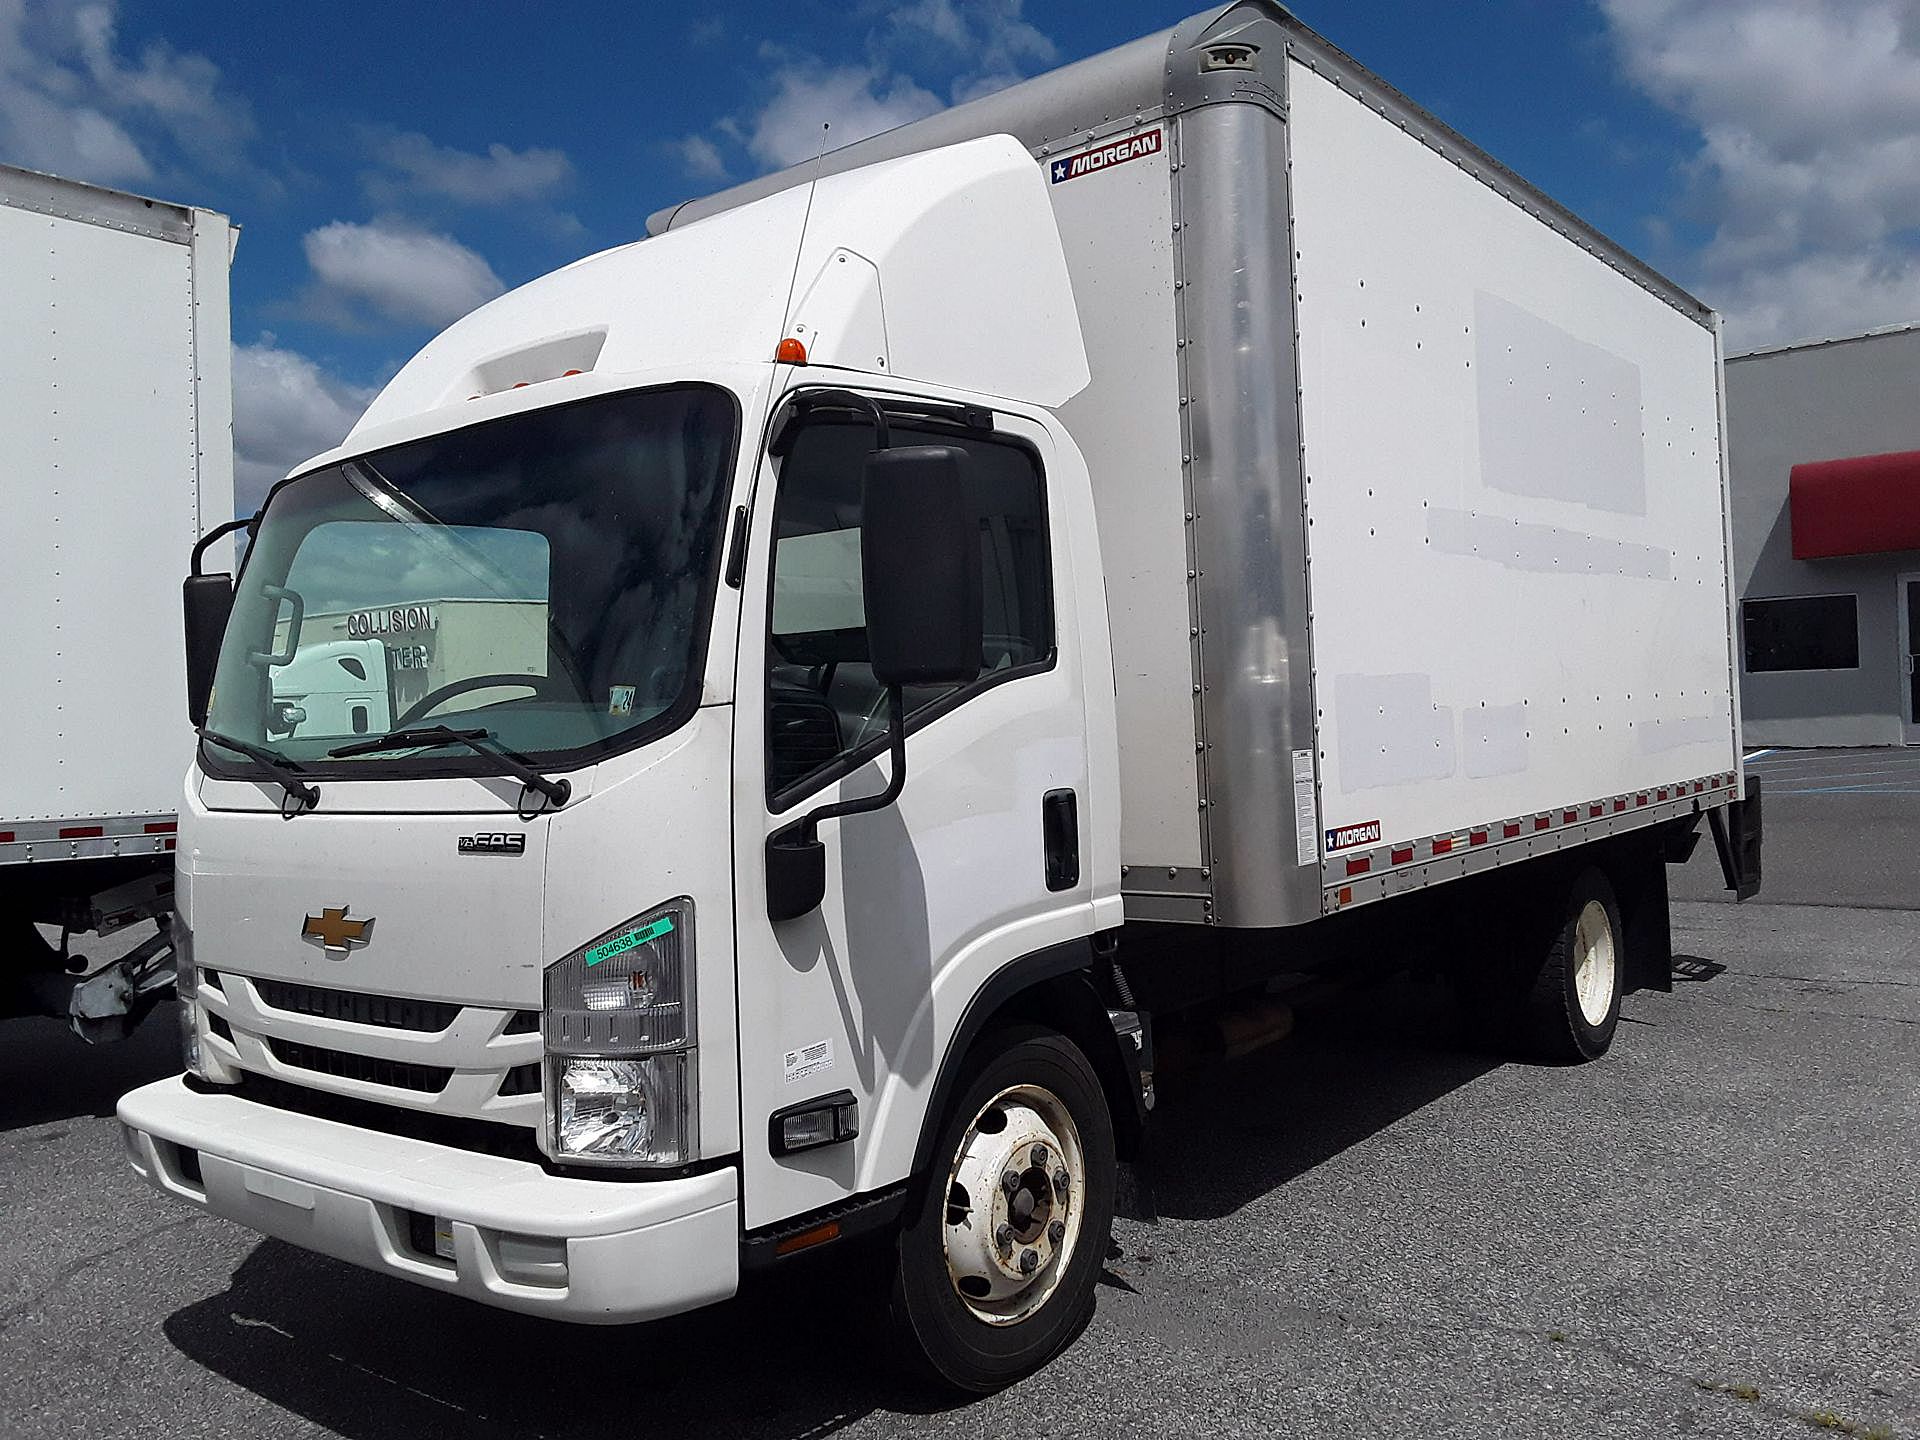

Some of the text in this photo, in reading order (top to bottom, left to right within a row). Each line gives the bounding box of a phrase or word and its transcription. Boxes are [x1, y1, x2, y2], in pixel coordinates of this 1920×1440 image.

[1071, 134, 1157, 175] MORGAN
[347, 607, 431, 635] COLLISION
[392, 645, 428, 669] TER
[1336, 825, 1379, 847] MORGAN
[596, 936, 633, 959] 504638
